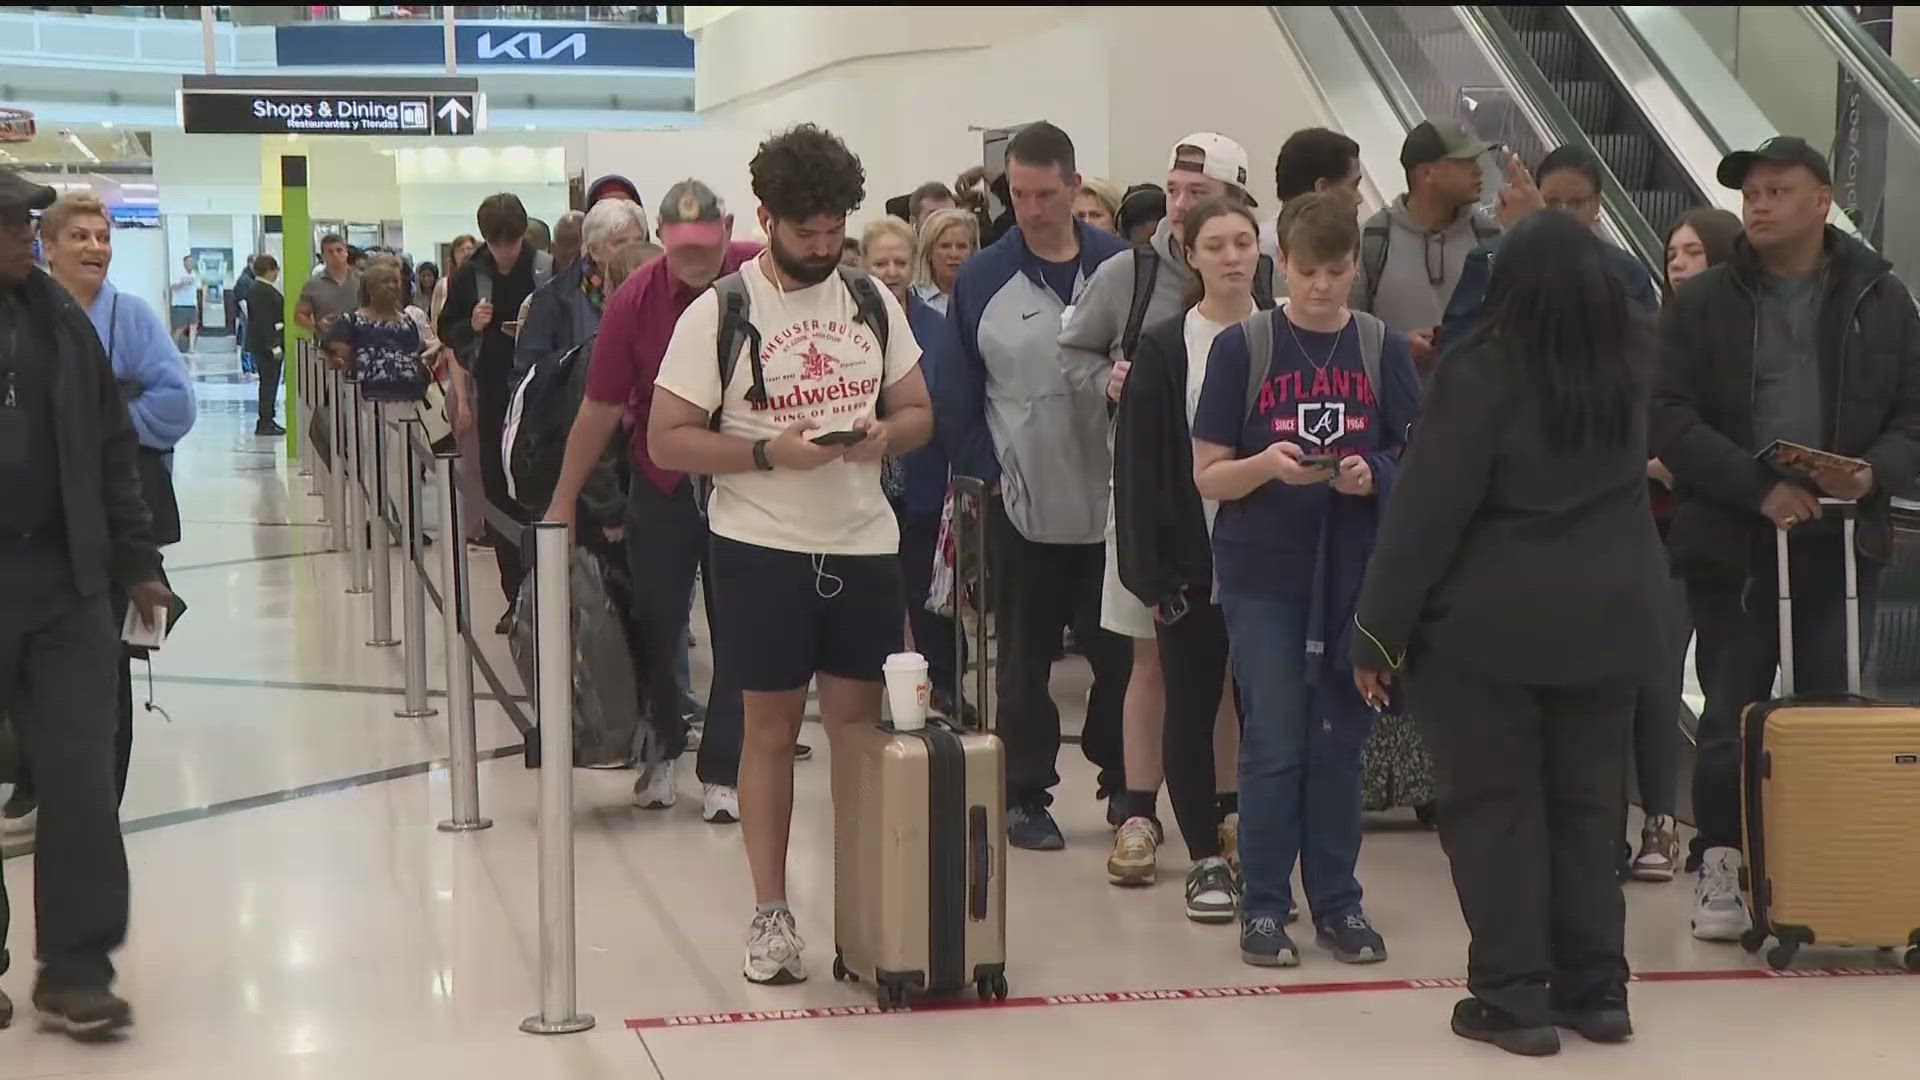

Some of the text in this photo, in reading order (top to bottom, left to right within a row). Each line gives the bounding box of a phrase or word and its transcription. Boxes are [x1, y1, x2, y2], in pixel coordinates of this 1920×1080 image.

[478, 31, 586, 60] KIA
[253, 100, 398, 120] Shops & Dining
[287, 119, 398, 130] Restaurantes y Tiendas
[774, 411, 806, 423] KING
[811, 409, 825, 419] OF
[1274, 417, 1365, 431] SINCE 1966
[1116, 988, 1184, 1001] WAIT
[665, 1012, 733, 1027] HERE
[739, 1008, 812, 1021] WAIT
